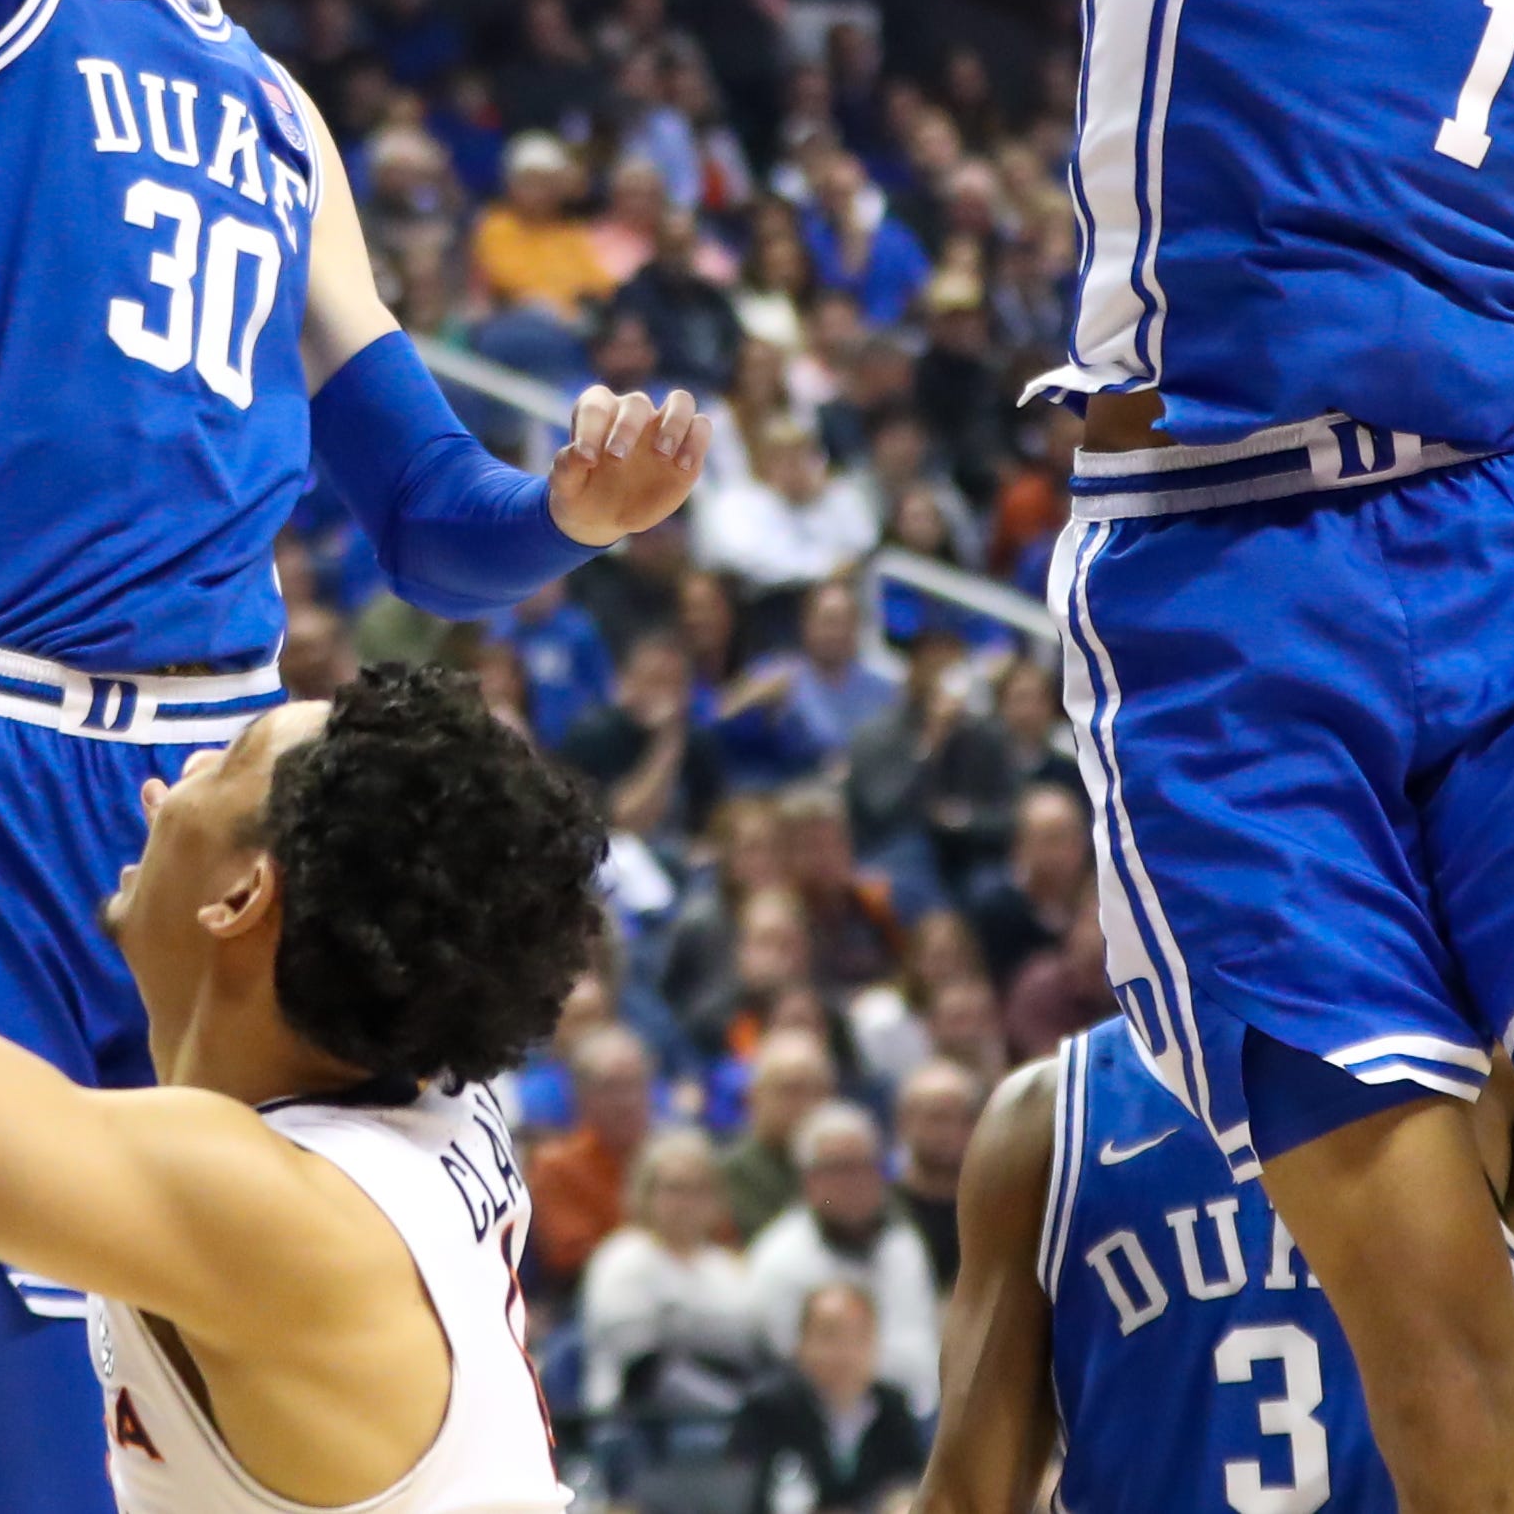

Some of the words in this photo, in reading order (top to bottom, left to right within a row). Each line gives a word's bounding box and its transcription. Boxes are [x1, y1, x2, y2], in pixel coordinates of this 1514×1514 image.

[77, 59, 308, 254] DUKE
[107, 179, 281, 410] 30
[1215, 1325, 1330, 1514] 3
